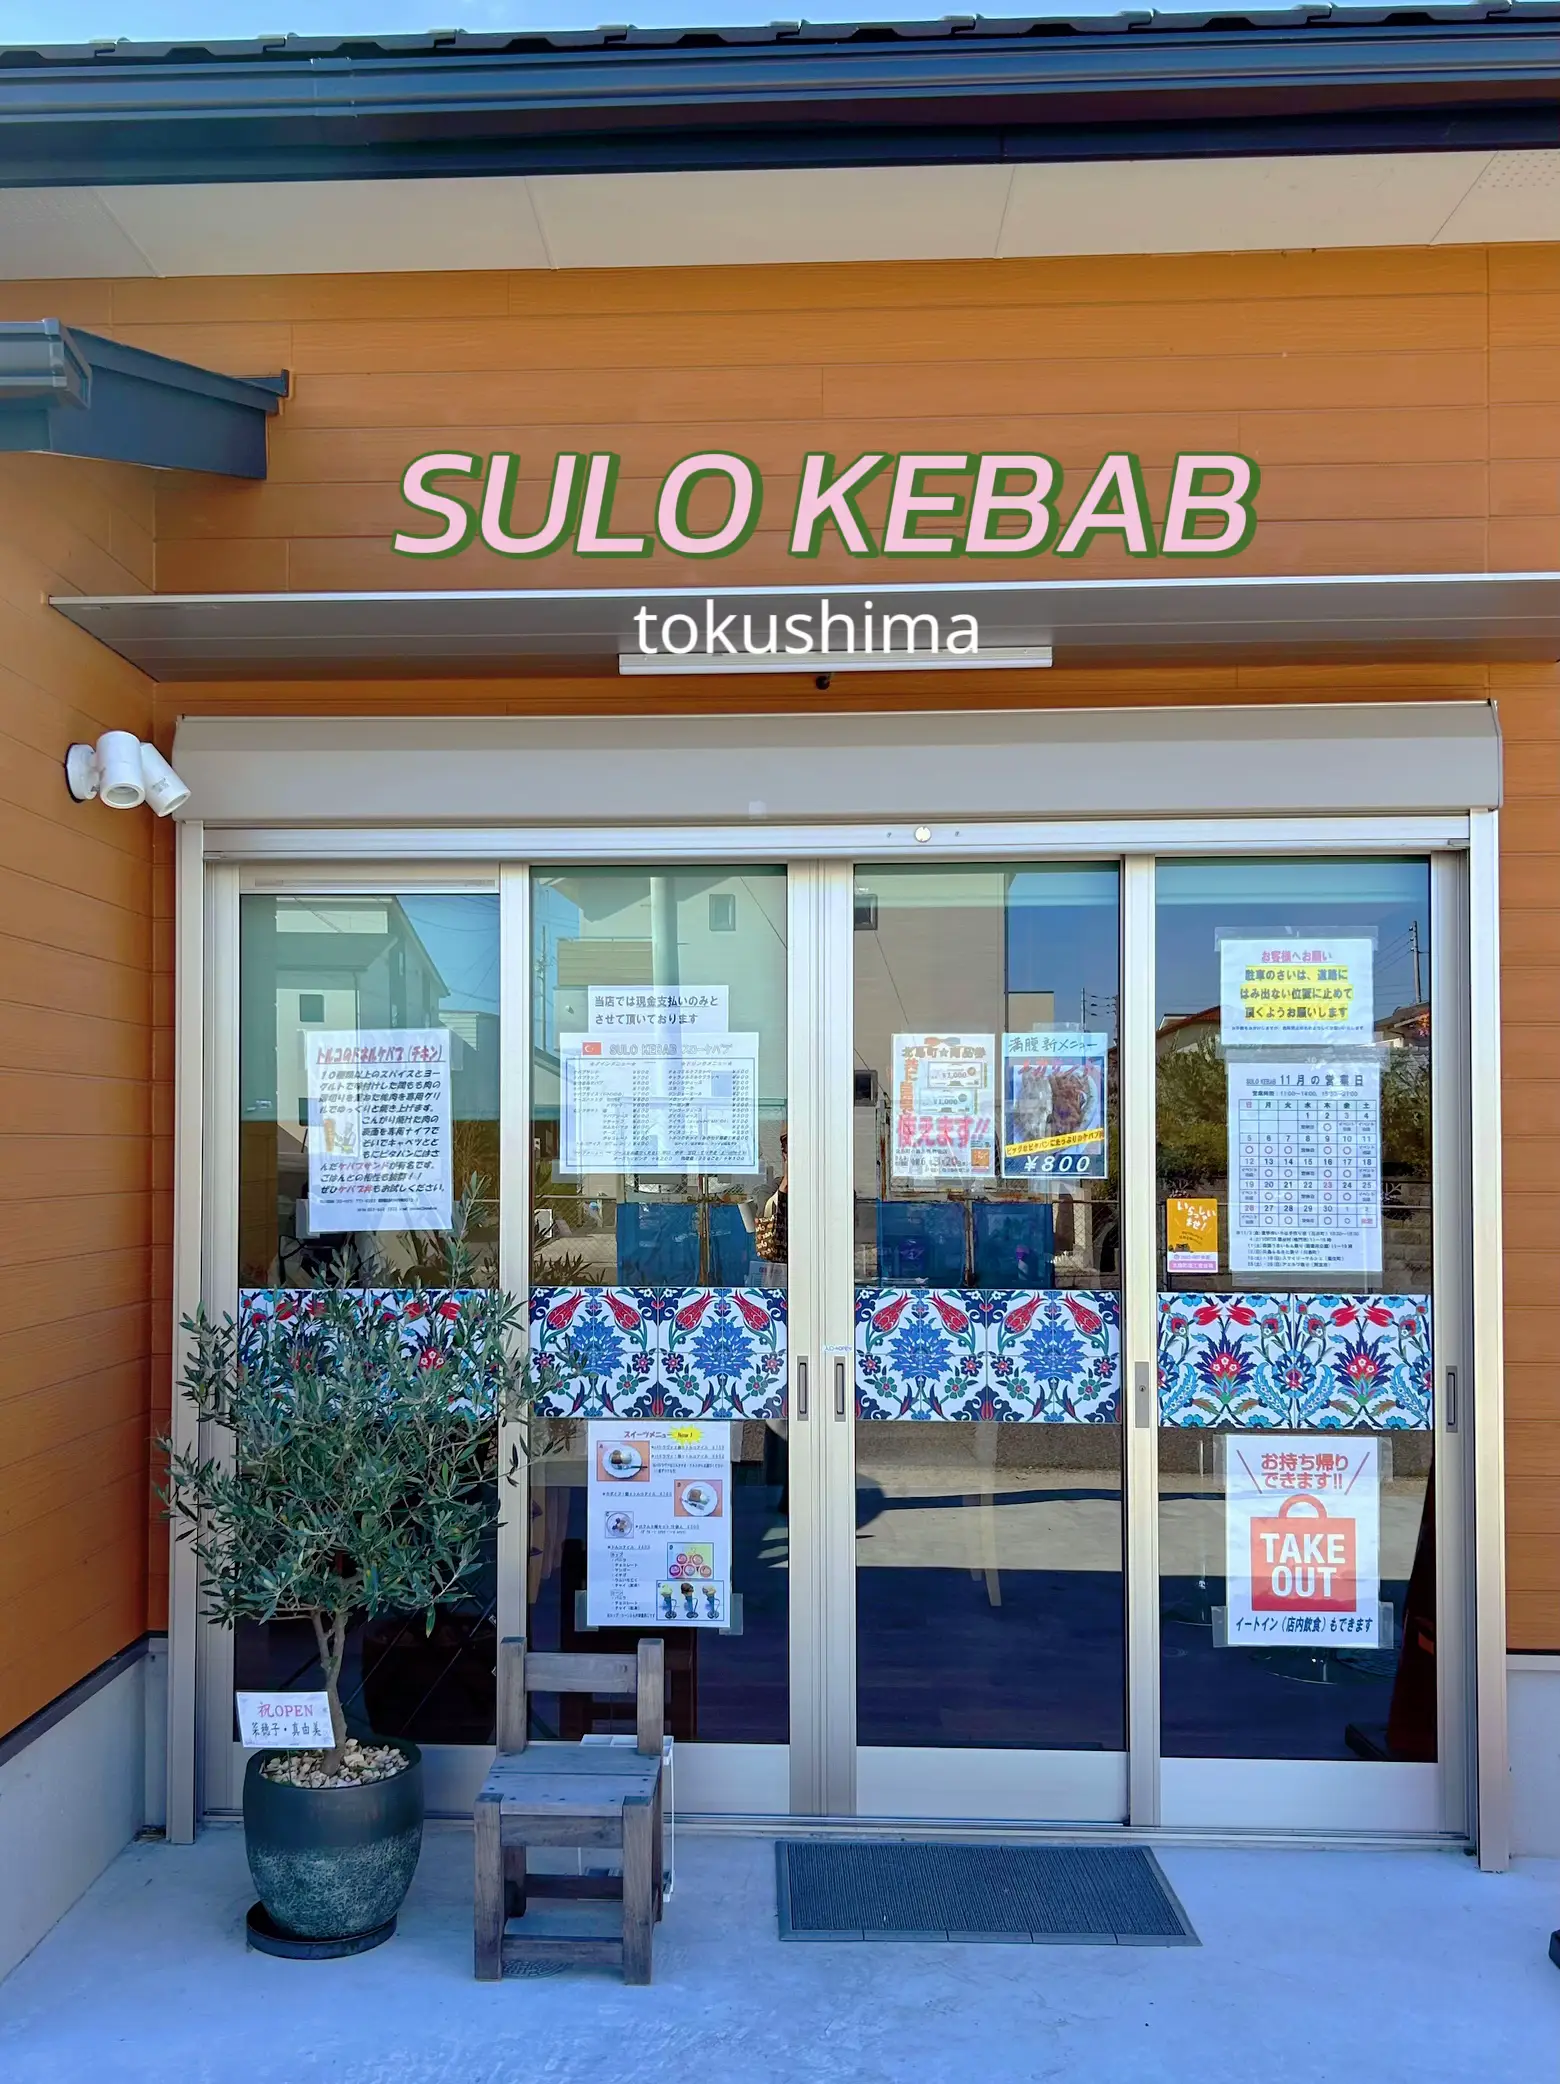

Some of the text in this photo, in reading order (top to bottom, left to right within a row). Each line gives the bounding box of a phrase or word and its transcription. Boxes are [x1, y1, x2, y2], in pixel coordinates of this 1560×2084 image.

[1262, 950, 1333, 963] お客様へお願い
[1245, 969, 1348, 981] 駐車のさいは、道路に
[1240, 987, 1353, 1000] はみ出ない位置に止めて
[594, 995, 719, 1008] 当店では現金支払いのみと
[595, 1013, 698, 1025] させて頂いております
[1245, 1006, 1348, 1018] 頂くようお願いします
[1024, 1155, 1091, 1173] ¥800
[1260, 1452, 1349, 1473] お持ち帰り
[1261, 1471, 1343, 1490] できます!!
[1259, 1533, 1346, 1565] TAKE
[1271, 1566, 1337, 1598] OUT
[1235, 1616, 1373, 1634] イートイン（店内飲食）もできます
